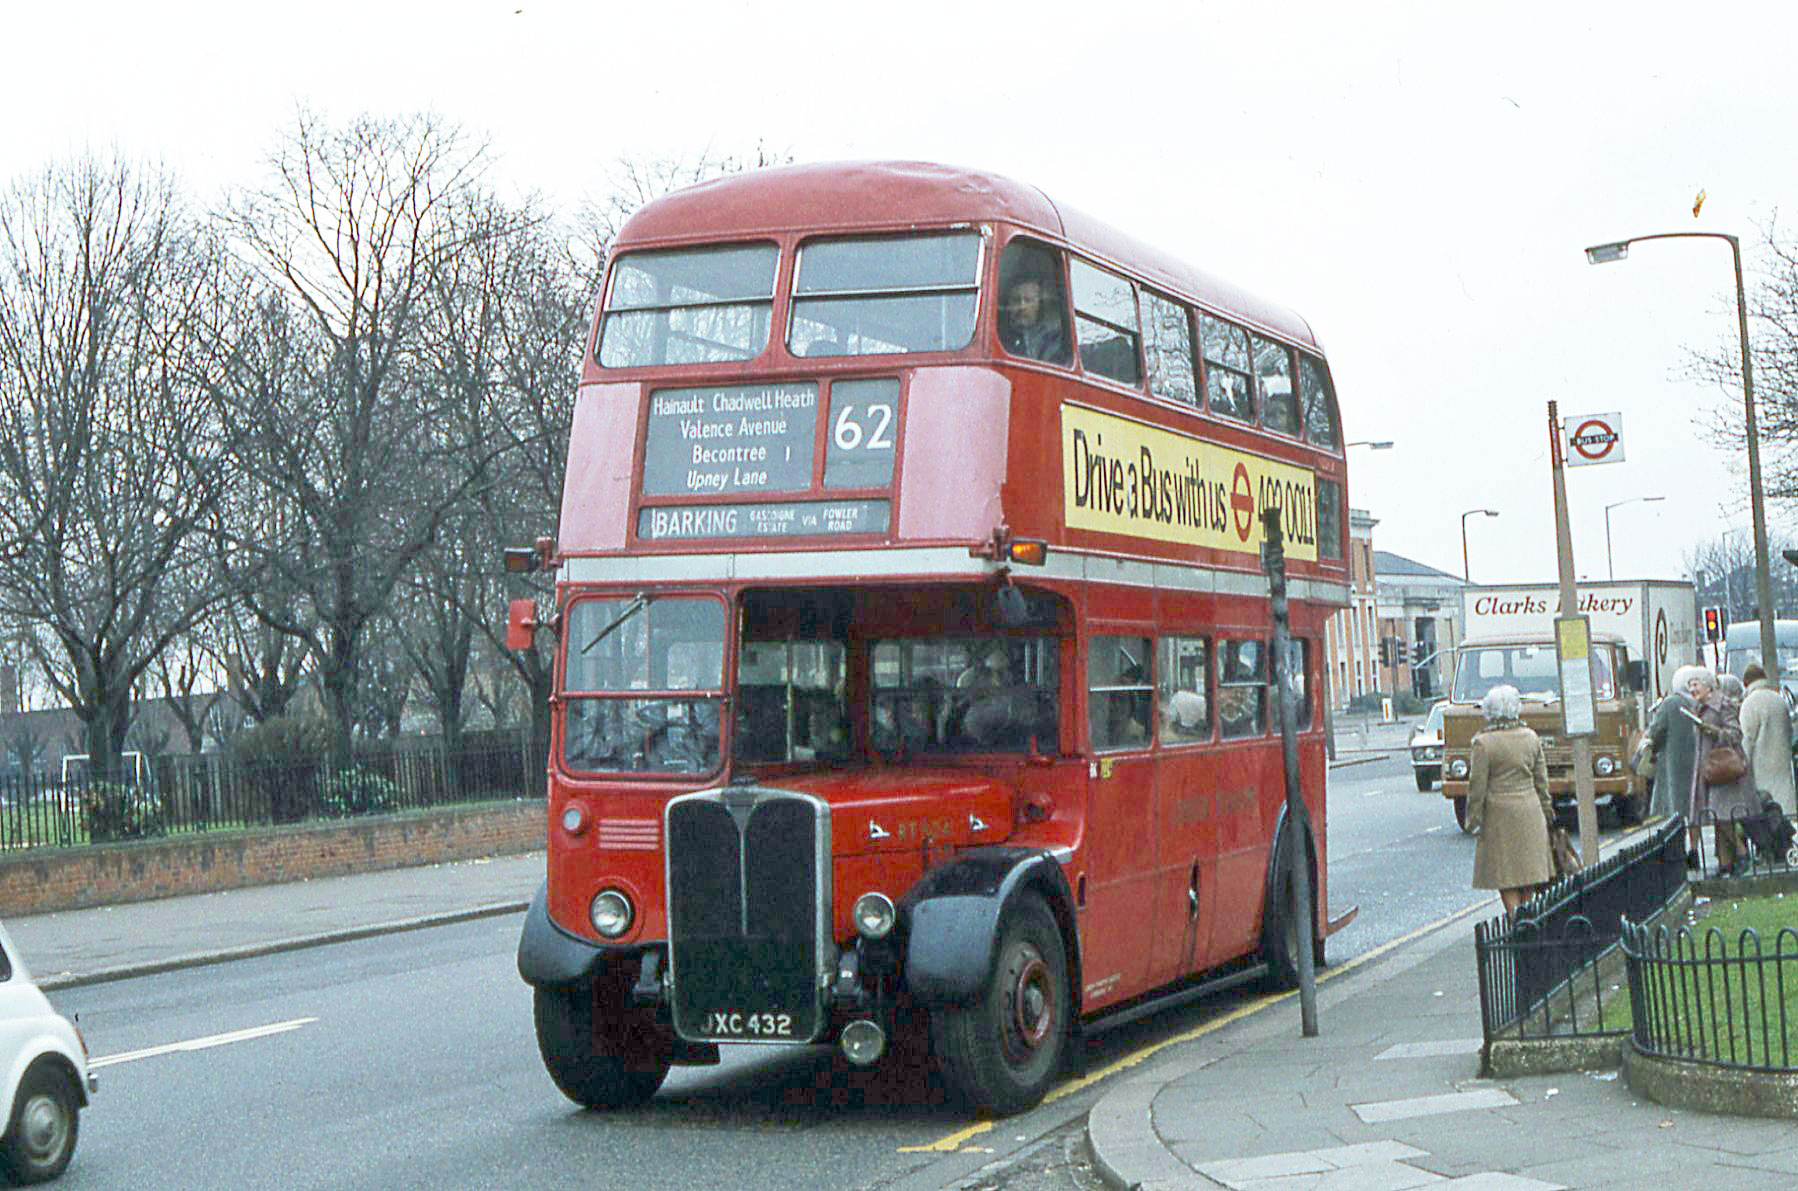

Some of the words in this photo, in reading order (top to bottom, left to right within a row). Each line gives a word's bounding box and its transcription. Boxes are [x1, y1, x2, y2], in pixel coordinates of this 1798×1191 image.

[653, 396, 704, 416] Hainault
[712, 392, 773, 413] Chadwell
[774, 389, 815, 409] Heath
[681, 418, 733, 439] Valence
[739, 416, 787, 436] Avenue
[834, 404, 892, 450] 62
[692, 444, 767, 464] Becontree
[687, 470, 729, 490] Upney
[734, 467, 768, 486] Lane
[1073, 428, 1124, 515] Drive
[1127, 462, 1138, 518] a
[1141, 446, 1172, 525] Bus
[1174, 456, 1205, 529] with
[1209, 481, 1227, 533] us
[656, 509, 738, 536] BARKING
[822, 507, 858, 519] FOWLER
[757, 521, 788, 533] ESATE
[828, 518, 853, 531] ROAD
[1475, 596, 1547, 615] Clarks
[700, 1013, 743, 1034] JXC
[747, 1013, 792, 1035] 432
